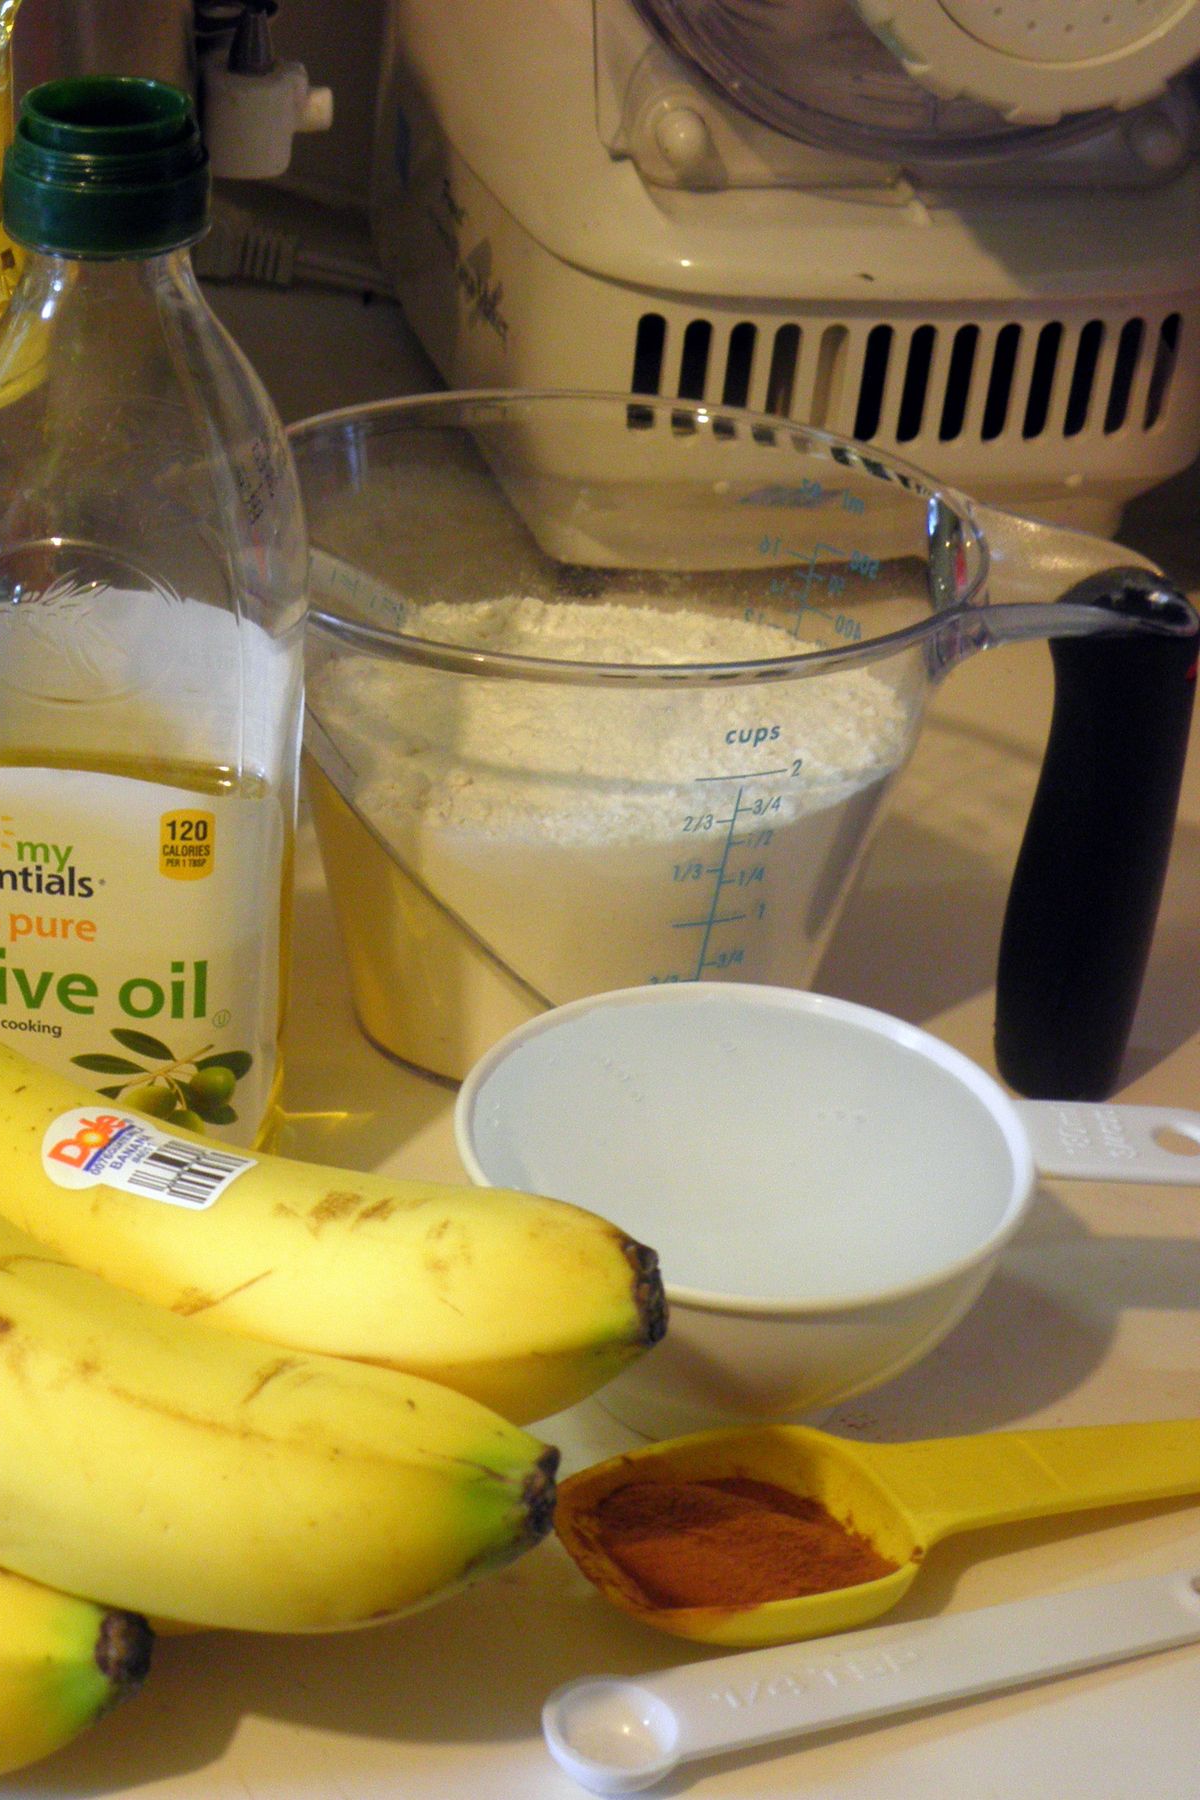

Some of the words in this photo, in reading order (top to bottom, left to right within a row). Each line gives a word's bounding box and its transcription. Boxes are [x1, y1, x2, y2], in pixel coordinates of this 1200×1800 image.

[725, 725, 781, 747] cups
[791, 759, 803, 777] 2
[752, 796, 782, 815] 3/4
[166, 820, 209, 842] 120
[683, 814, 714, 833] 2/3
[16, 841, 74, 872] my
[162, 844, 211, 857] CALORIES
[166, 858, 180, 867] PER
[672, 864, 704, 883] 1/3
[737, 867, 766, 886] 1/4
[9, 911, 98, 942] pure
[118, 960, 209, 1020] oil
[0, 1019, 63, 1039] cooking
[47, 1114, 127, 1169] Dole
